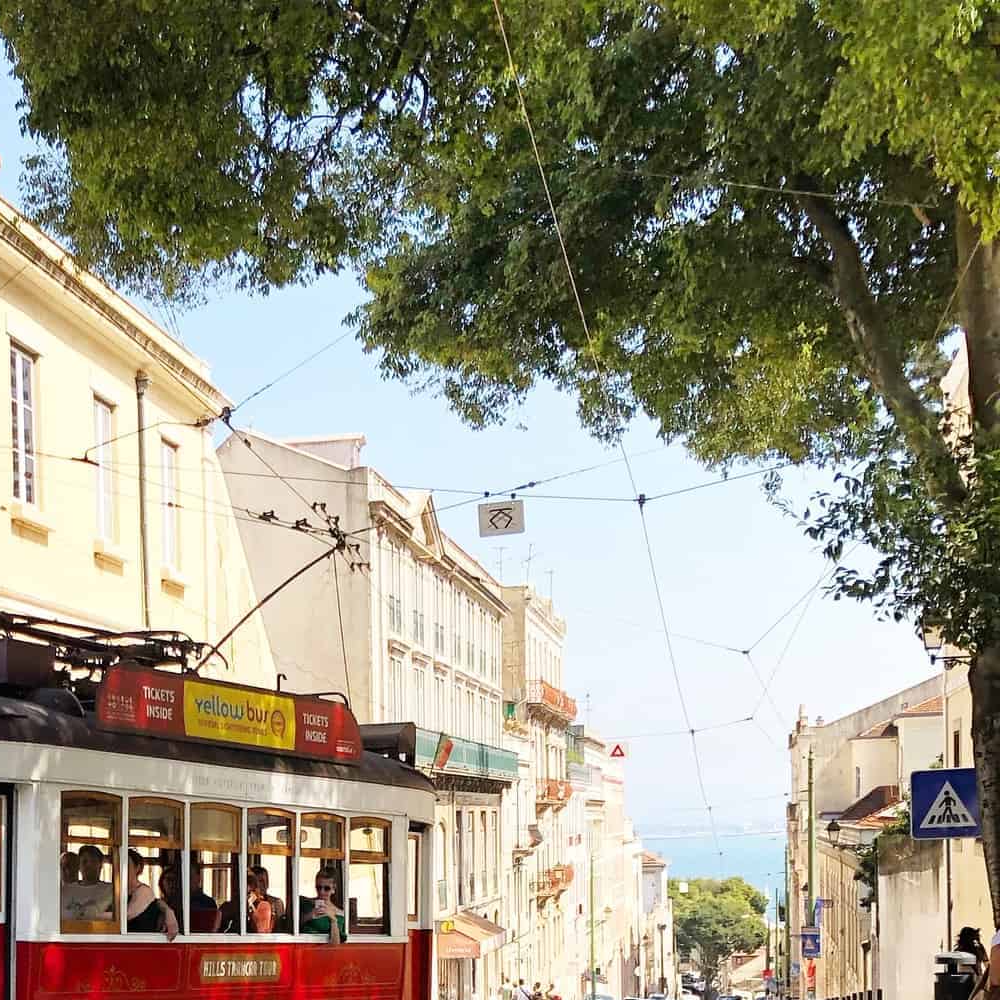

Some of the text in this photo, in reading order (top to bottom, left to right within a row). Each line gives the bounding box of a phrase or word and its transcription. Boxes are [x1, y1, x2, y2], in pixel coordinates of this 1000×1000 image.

[142, 685, 176, 703] TICKETS
[146, 704, 173, 721] INSIDE
[246, 700, 268, 723] bus
[302, 712, 329, 728] TICKETS
[305, 729, 327, 744] INSIDE
[203, 960, 226, 977] HILLS
